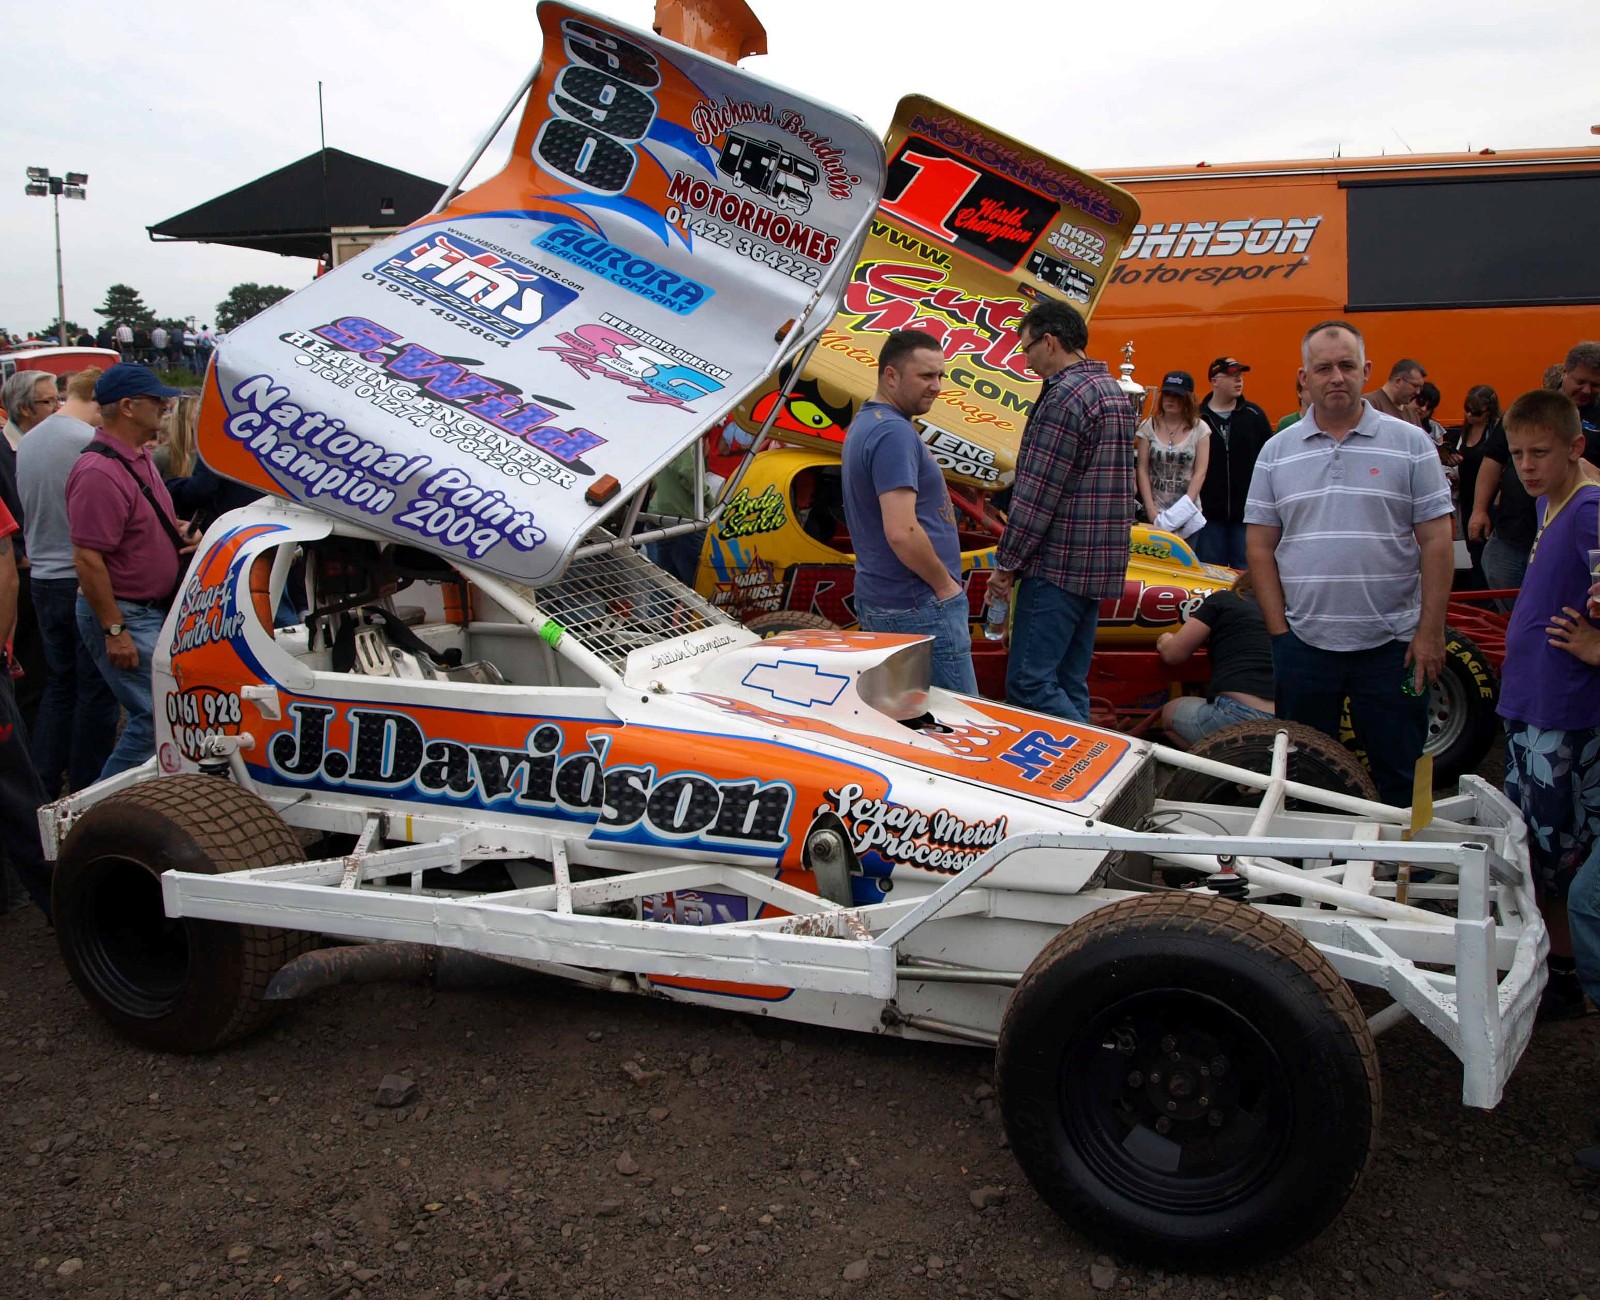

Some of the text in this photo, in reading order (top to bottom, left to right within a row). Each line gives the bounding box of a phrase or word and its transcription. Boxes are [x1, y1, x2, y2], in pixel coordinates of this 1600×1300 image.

[531, 18, 661, 197] 390
[691, 94, 862, 200] Richard Baldwin
[908, 114, 1123, 225] MOTORHOMES
[666, 170, 840, 265] MOTORHOMES
[879, 149, 982, 243] 1
[953, 207, 1033, 242] Champion
[447, 227, 585, 291] www.HMSRACEPARTS.com
[546, 227, 706, 306] AURORA
[665, 206, 821, 287] 01422 364222
[1048, 231, 1105, 267] 364222
[1059, 222, 1105, 252] 01422
[1120, 216, 1322, 260] OHNSON
[537, 239, 690, 313] BEARING COMPANY
[362, 272, 513, 348] 01924 492864
[562, 334, 599, 355] SPEEDYS
[610, 358, 640, 376] SIGNS
[285, 331, 578, 489] HEATING ENGINEER
[311, 359, 523, 477] Tel: 01274 678426
[913, 419, 996, 464] TENG
[224, 412, 502, 559] Champion 2009
[232, 373, 547, 551] National Points
[934, 453, 1000, 481] OOLS
[719, 484, 784, 520] Andy
[719, 504, 788, 540] Smith
[179, 569, 234, 617] Stuart
[171, 617, 211, 656] Smith
[1446, 640, 1493, 699] EAGLE
[202, 692, 242, 724] 928
[268, 705, 796, 849] J.Davidson
[813, 784, 1008, 845] Scrap Metal
